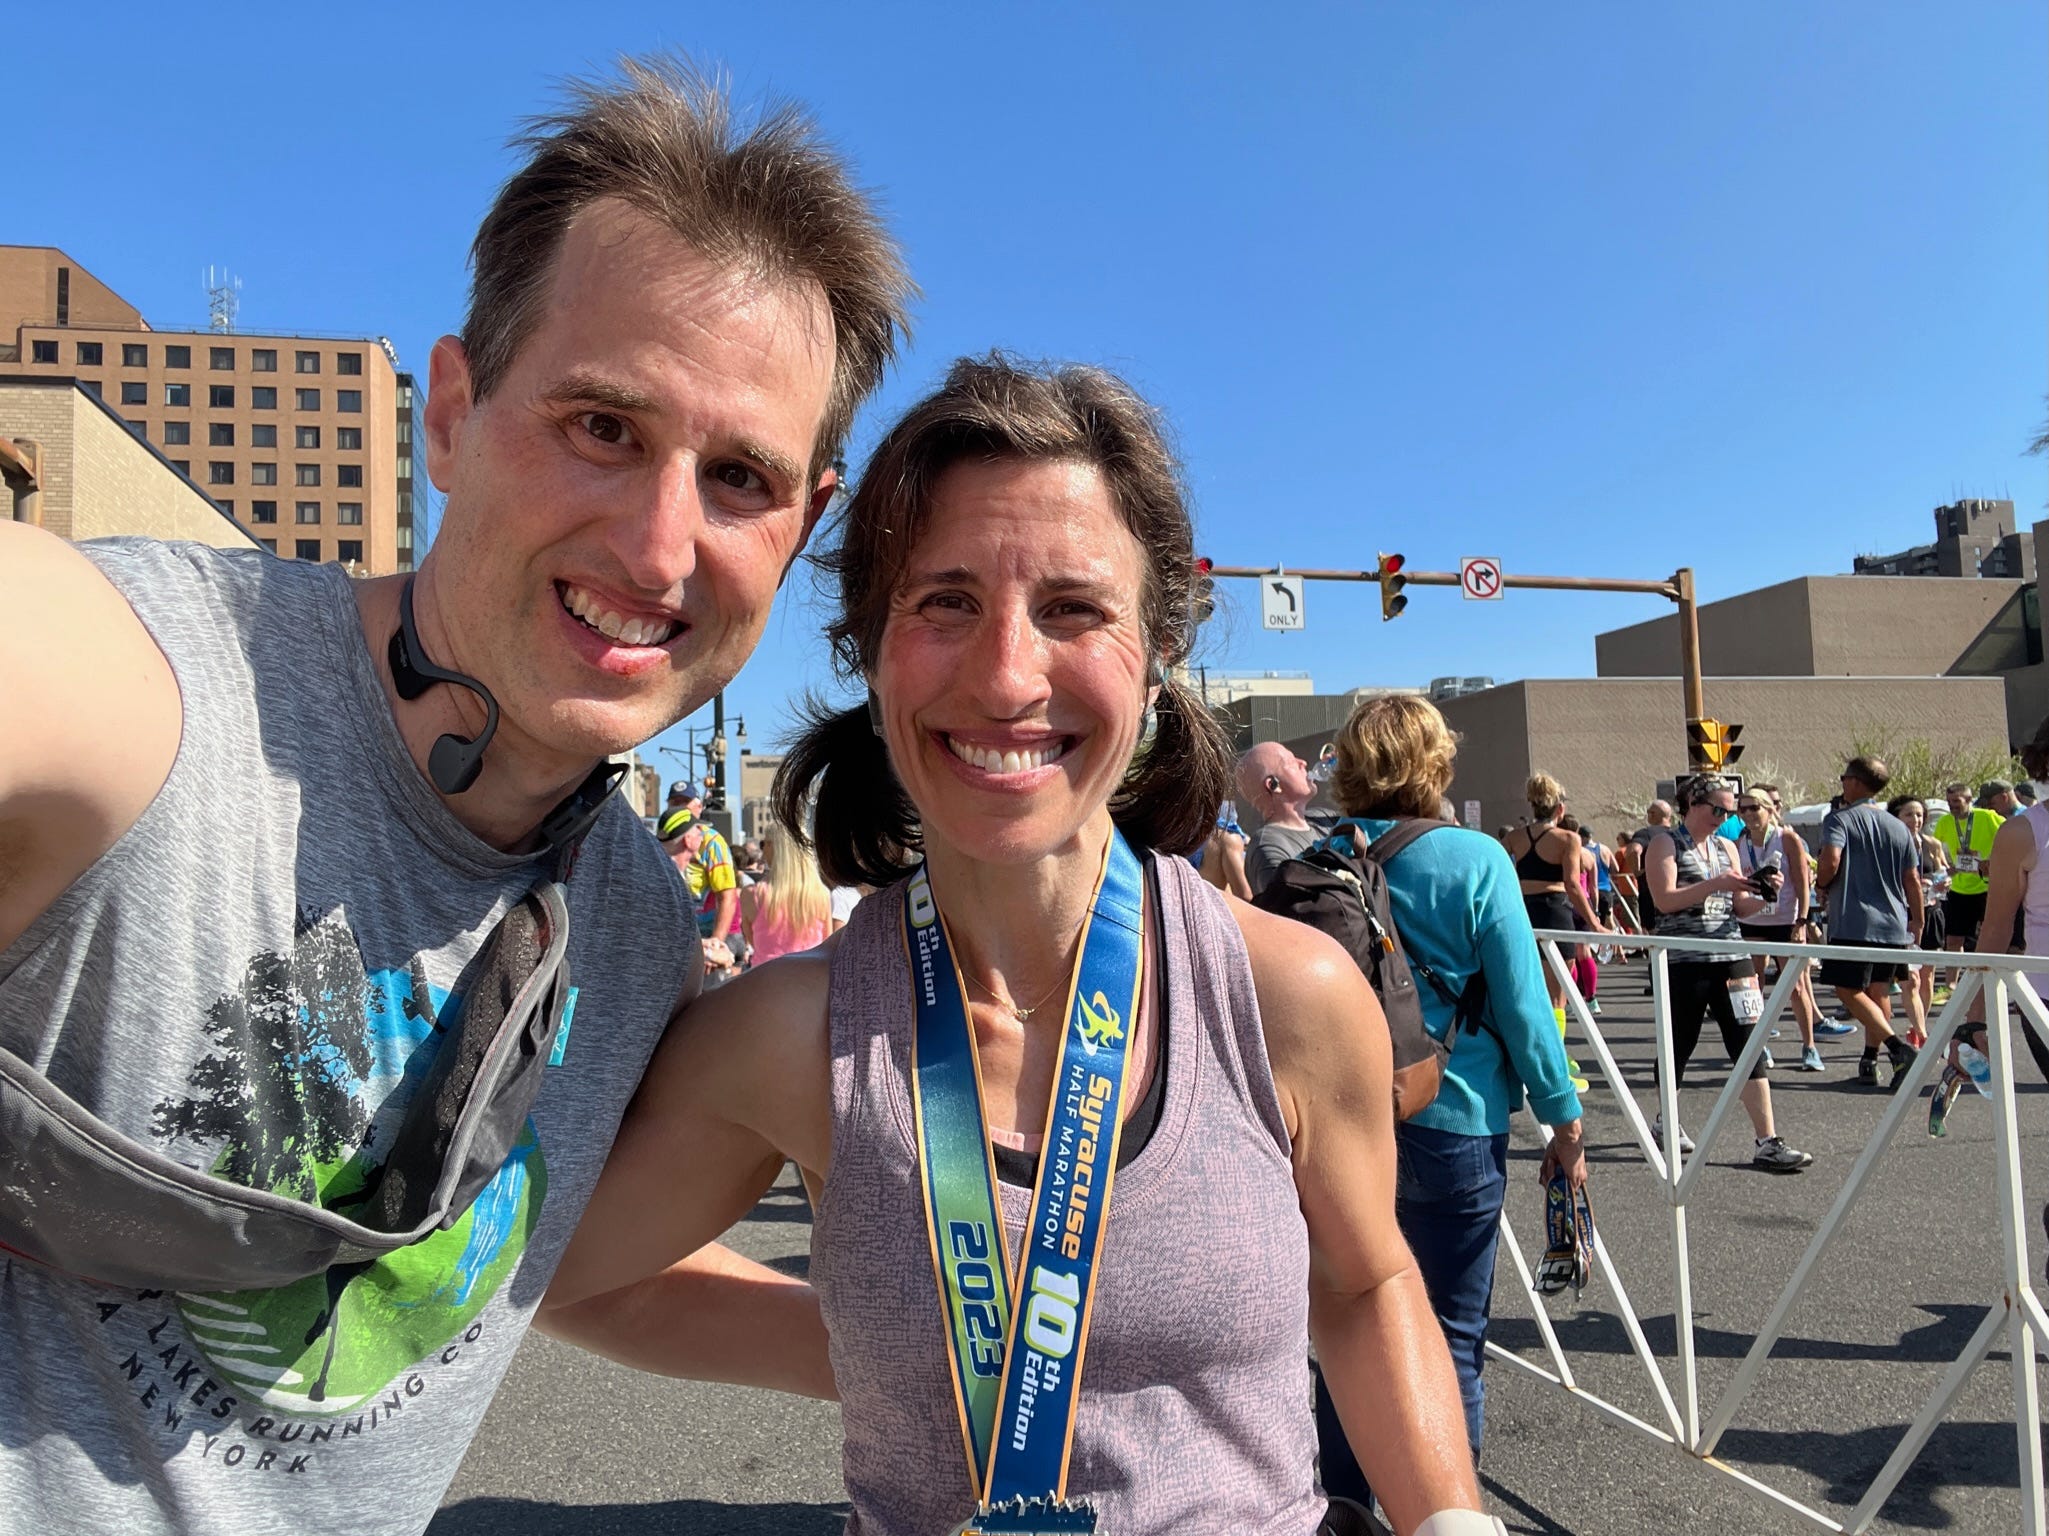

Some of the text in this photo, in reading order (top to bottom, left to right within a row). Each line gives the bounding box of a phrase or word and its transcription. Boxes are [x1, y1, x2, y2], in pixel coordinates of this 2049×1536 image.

[1269, 614, 1298, 626] ONLY
[917, 928, 937, 1006] Edition
[1042, 1064, 1086, 1250] HALF MARATHON
[1061, 1073, 1113, 1260] Syracuse
[948, 1219, 1003, 1379] 2023
[119, 1351, 184, 1433] NEW
[201, 1436, 313, 1474] YORK
[147, 1315, 483, 1443] LAKES RUNNING CO
[1012, 1350, 1043, 1451] Edition
